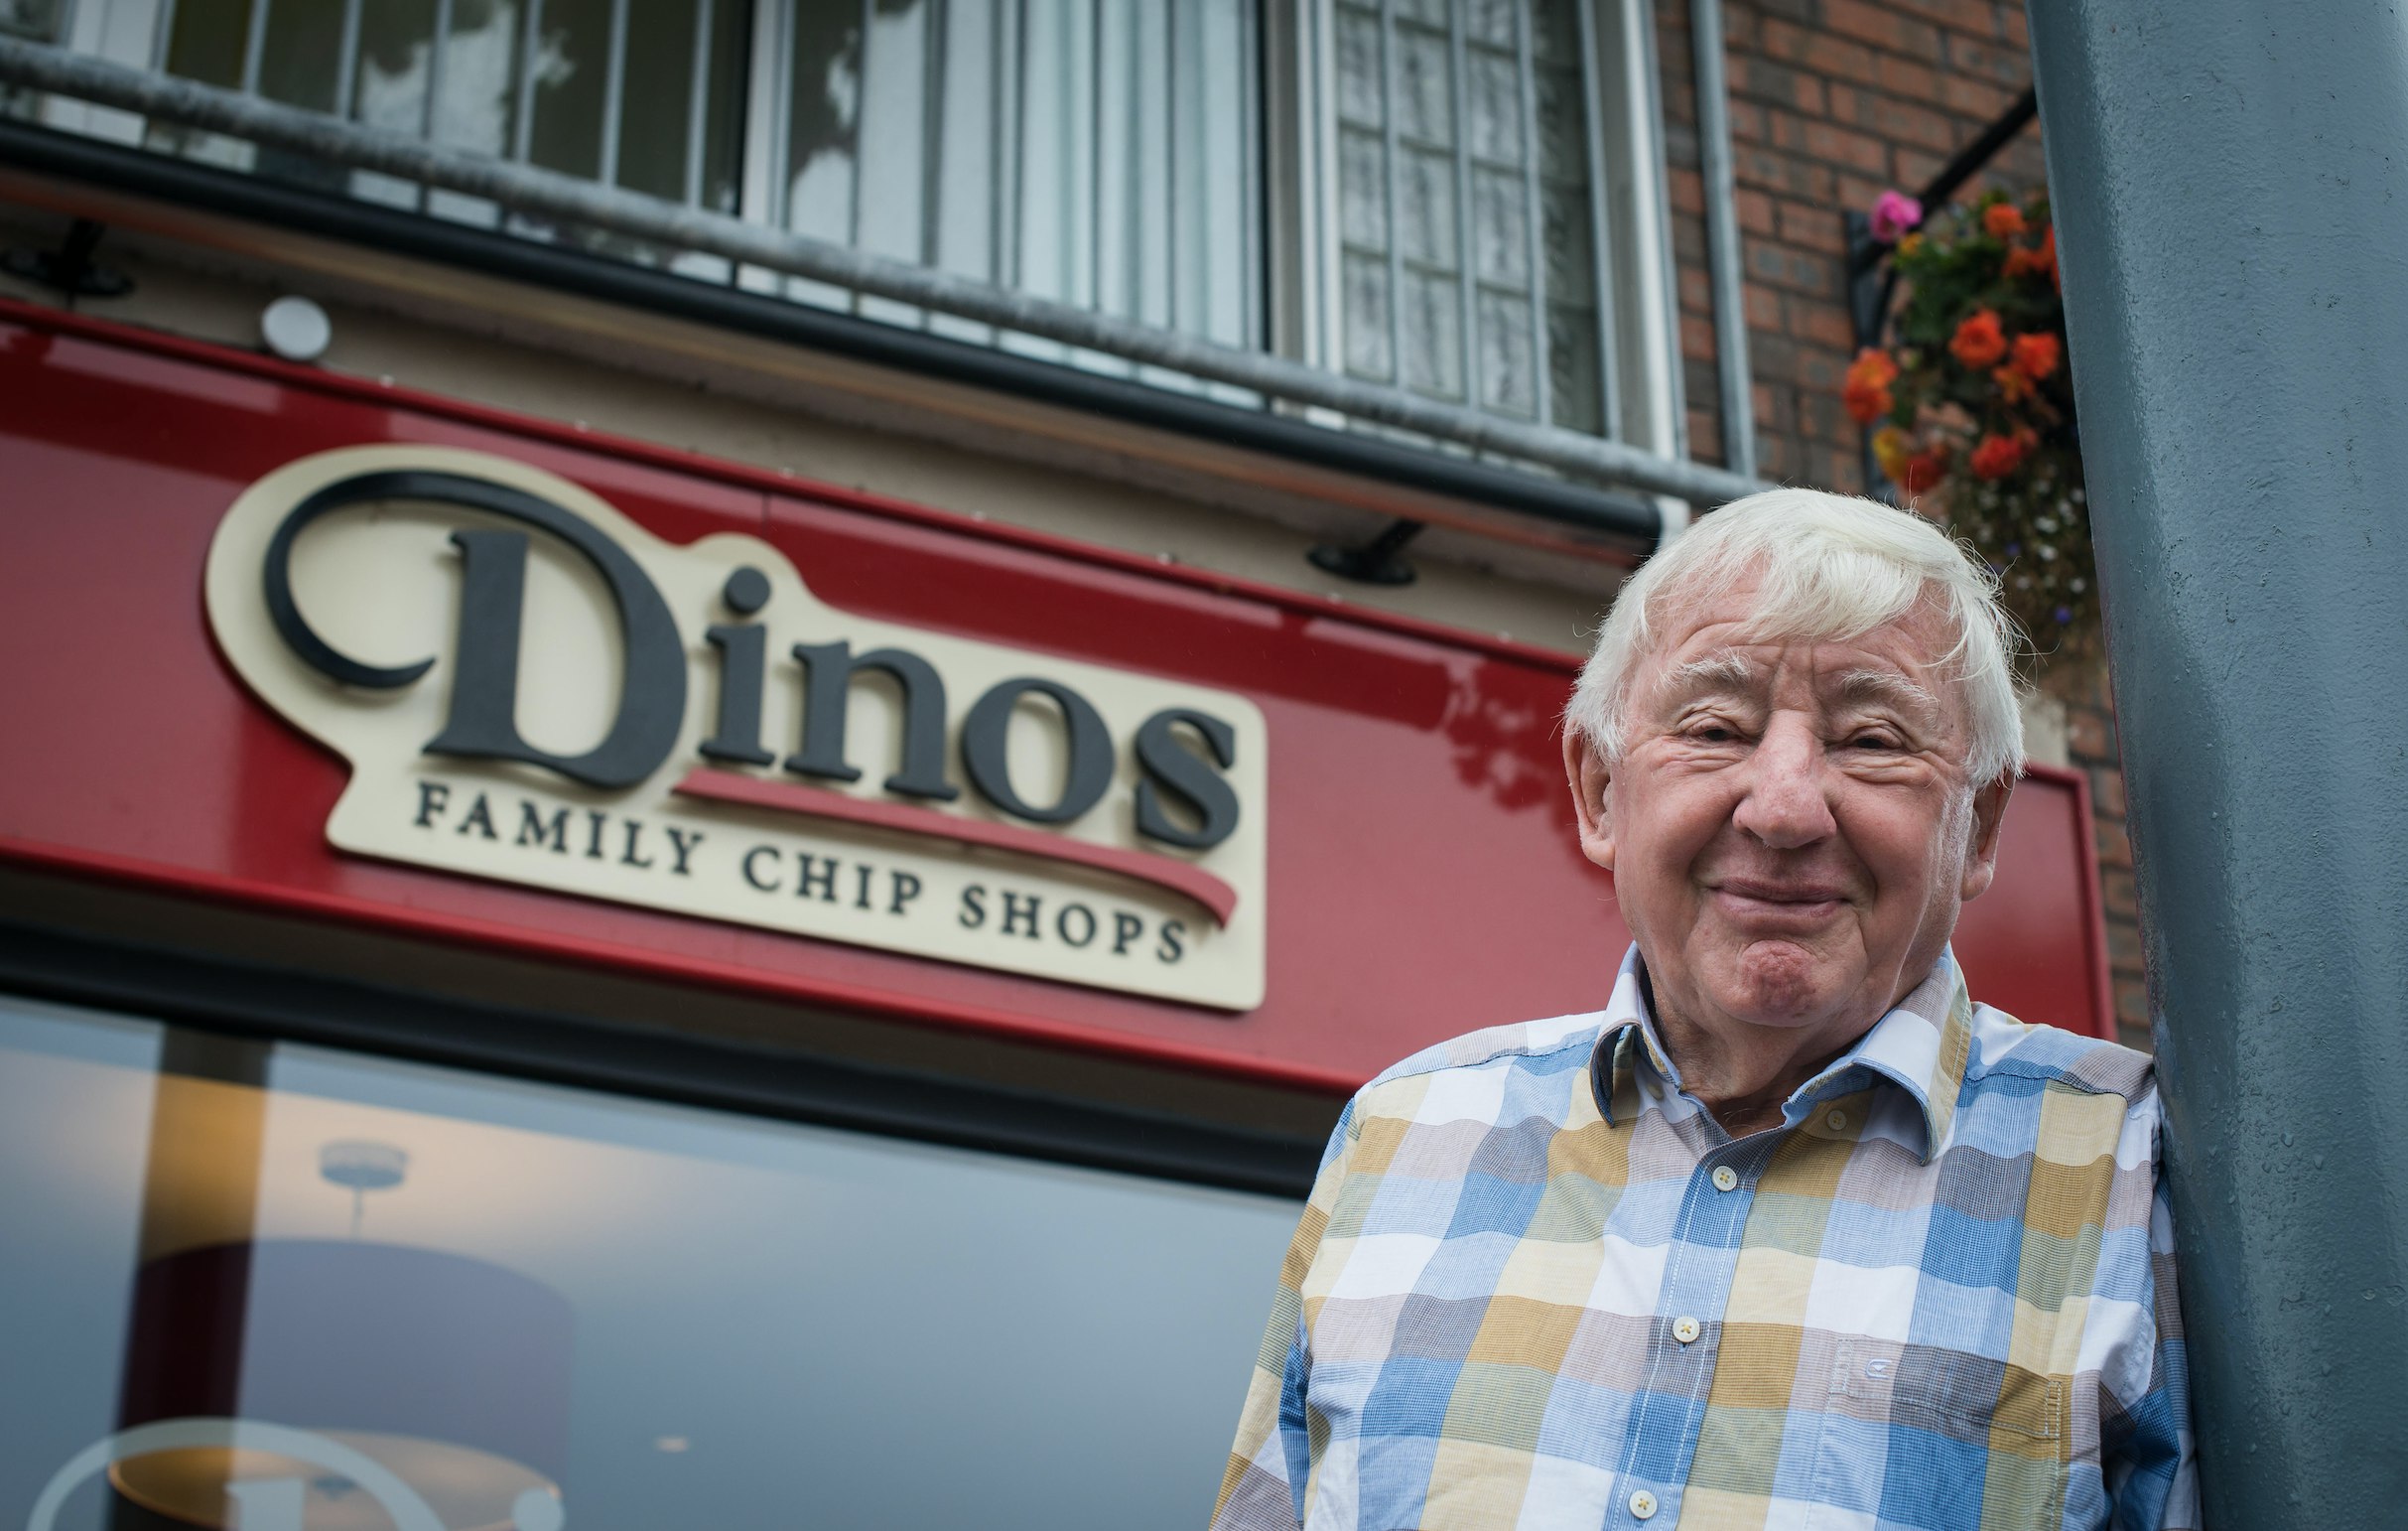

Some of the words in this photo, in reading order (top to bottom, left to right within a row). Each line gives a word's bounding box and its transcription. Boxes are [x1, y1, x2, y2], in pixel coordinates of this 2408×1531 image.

[263, 470, 1240, 850] Dinos
[412, 781, 707, 877] FAMILY
[740, 844, 923, 915] CHIP
[957, 884, 1188, 965] SHOPS
